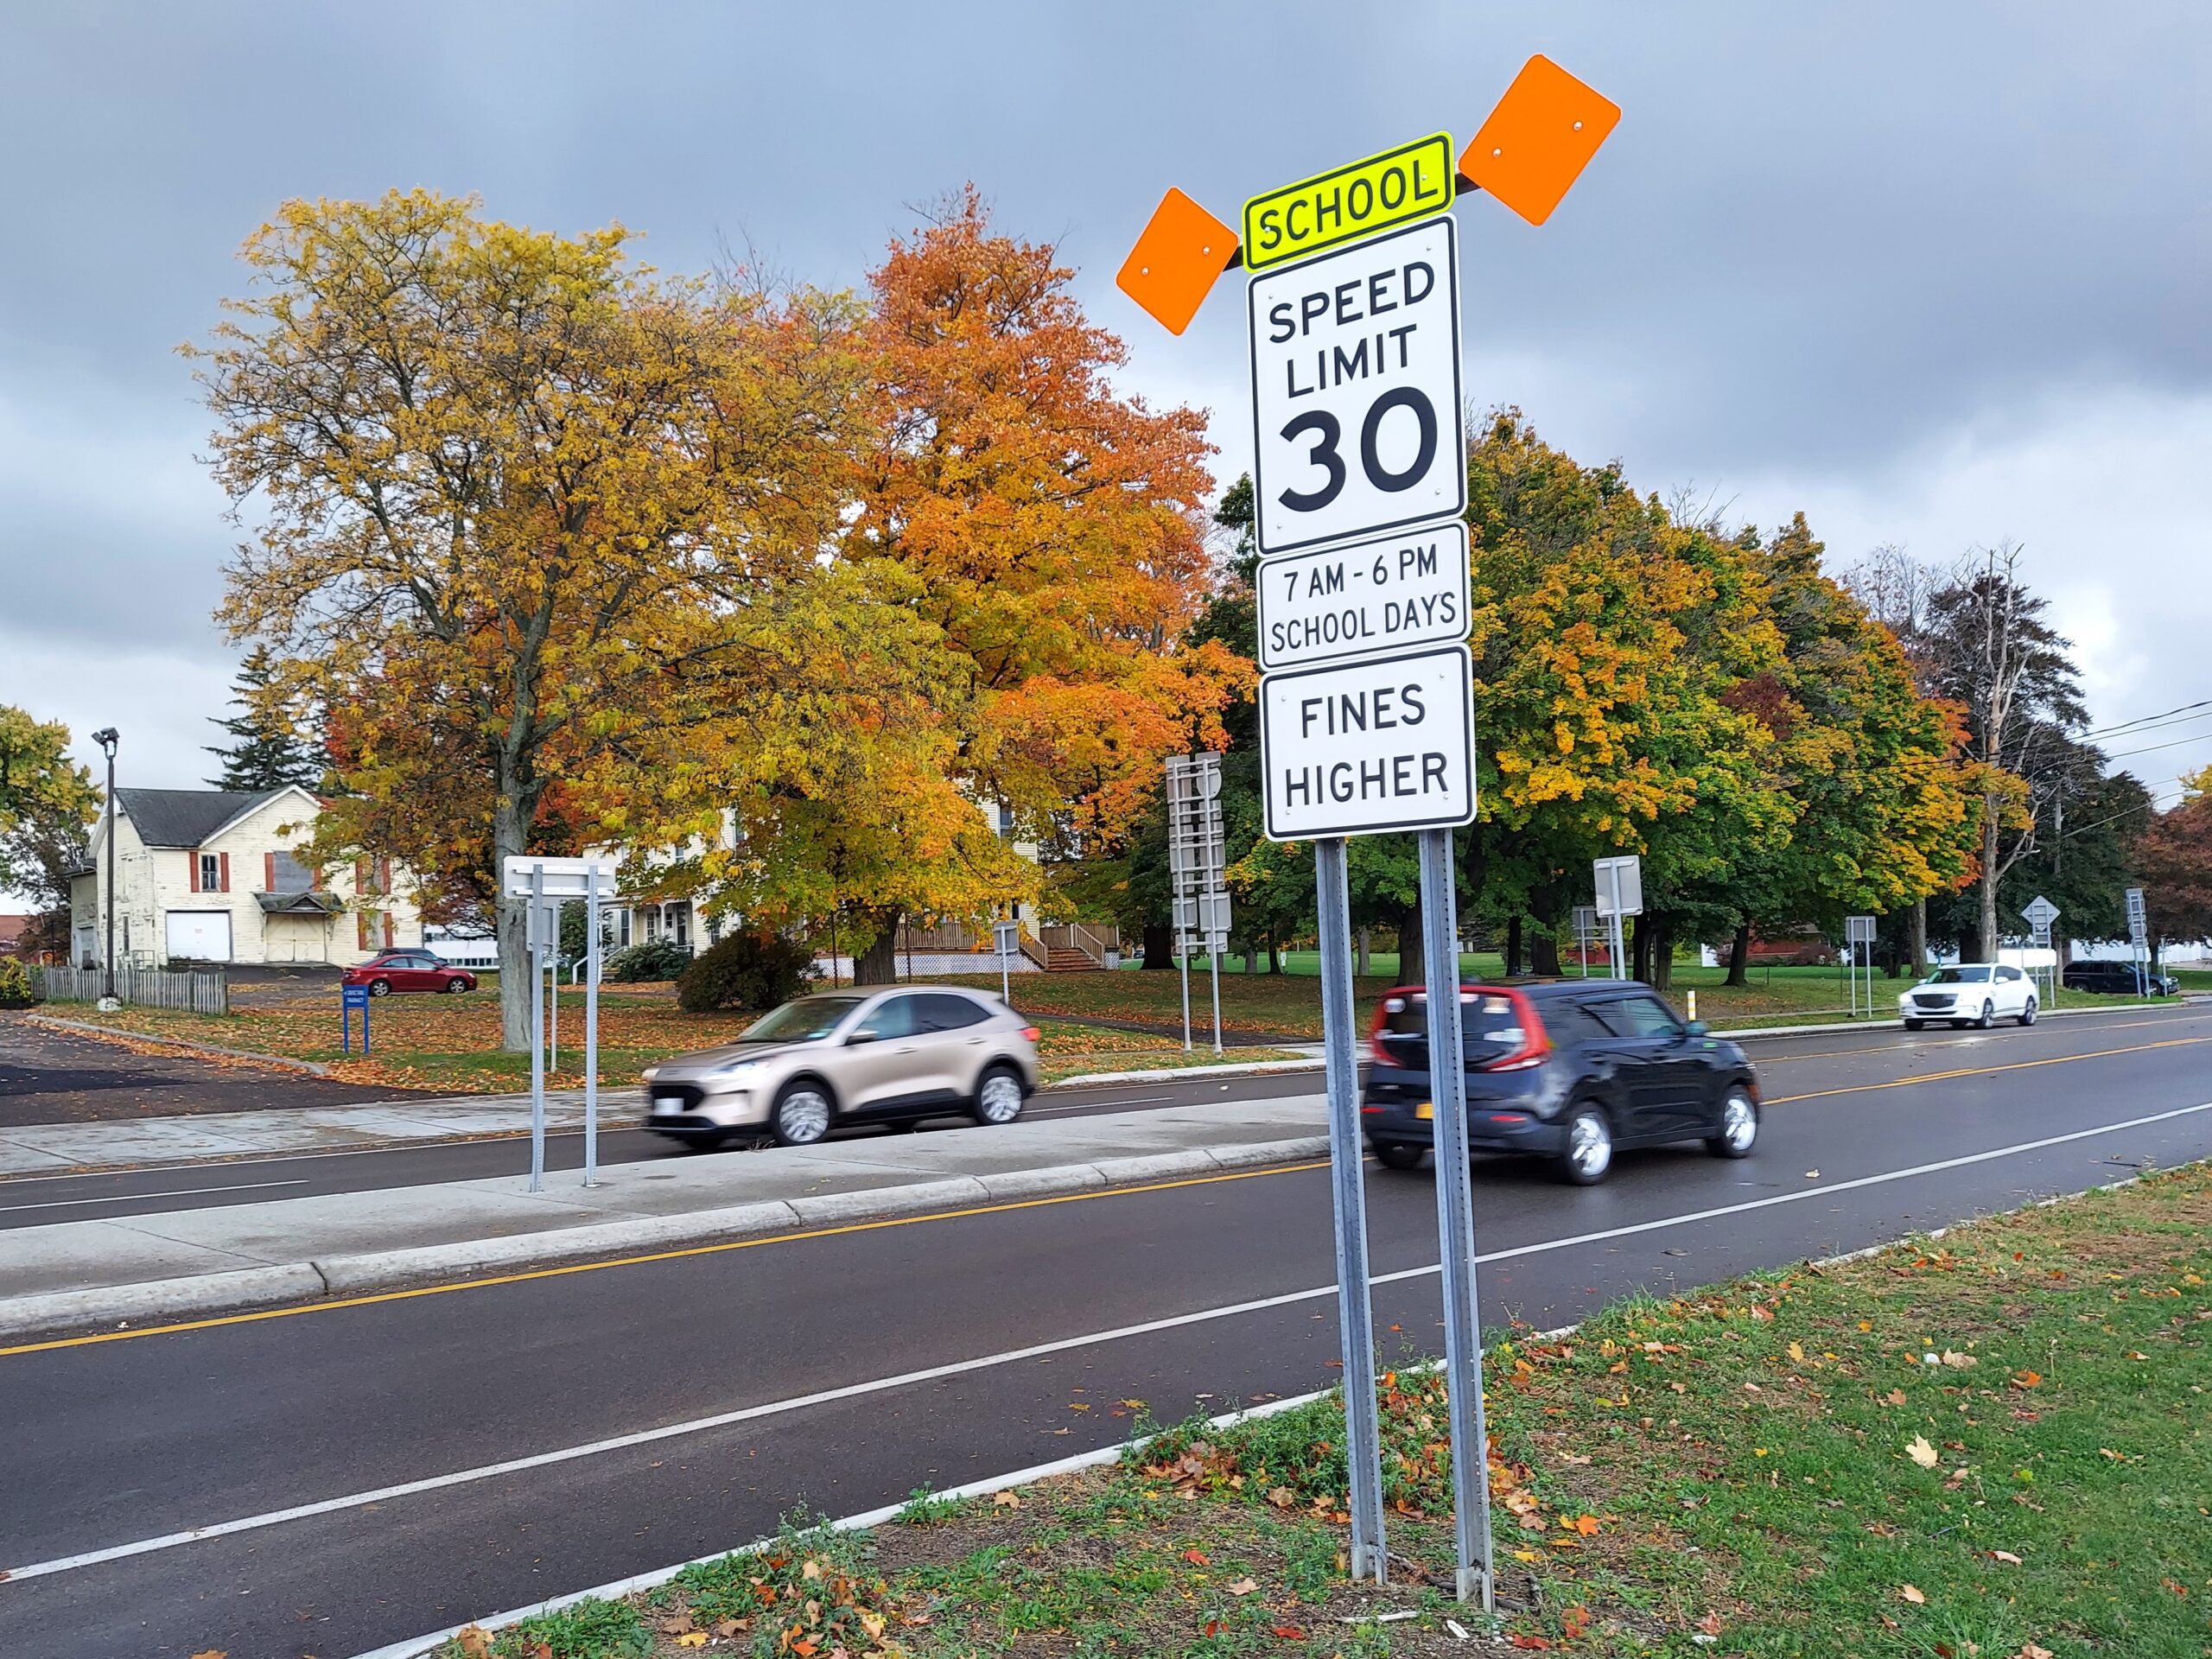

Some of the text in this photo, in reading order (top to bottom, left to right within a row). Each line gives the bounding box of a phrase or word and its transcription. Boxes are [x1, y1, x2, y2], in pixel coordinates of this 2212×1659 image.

[1260, 160, 1438, 250] SCHOOL
[1269, 261, 1434, 344] SPEED
[1287, 323, 1417, 398] LIMIT
[1278, 386, 1438, 512] 30
[1284, 571, 1299, 602] 7
[1308, 563, 1344, 598] AM
[1372, 555, 1389, 585] 6
[1399, 543, 1437, 581] PM
[1271, 591, 1456, 652] SCHOOL DAYS
[1301, 683, 1426, 739] FINES
[1285, 752, 1449, 808] HIGHER
